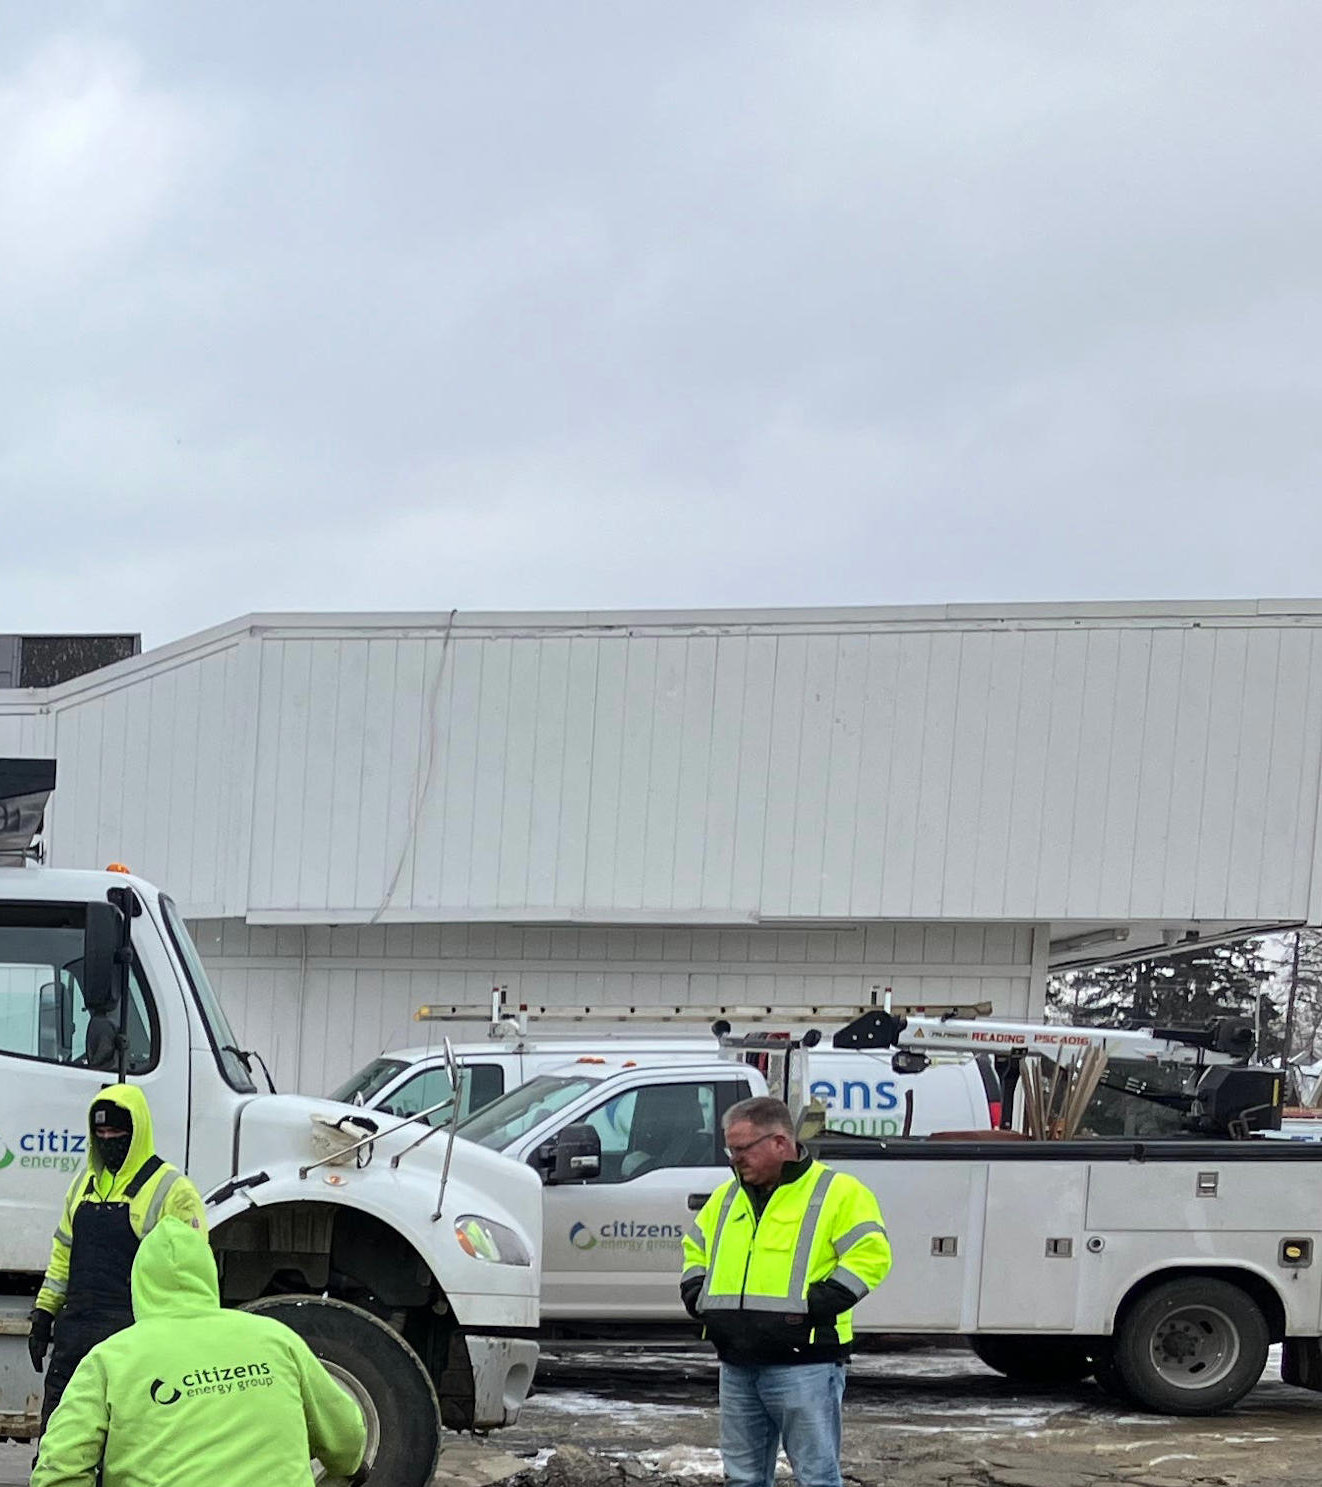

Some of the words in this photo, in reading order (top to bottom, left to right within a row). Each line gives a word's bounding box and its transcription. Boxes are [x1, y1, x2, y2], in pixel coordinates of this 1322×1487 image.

[971, 1031, 1026, 1045] READING
[828, 1117, 898, 1136] roup
[19, 1128, 87, 1153] citiz
[20, 1154, 82, 1172] energy
[599, 1220, 683, 1238] citizens
[600, 1240, 644, 1252] energy
[182, 1361, 271, 1388] citizens
[186, 1382, 233, 1398] energy
[237, 1376, 274, 1391] group
